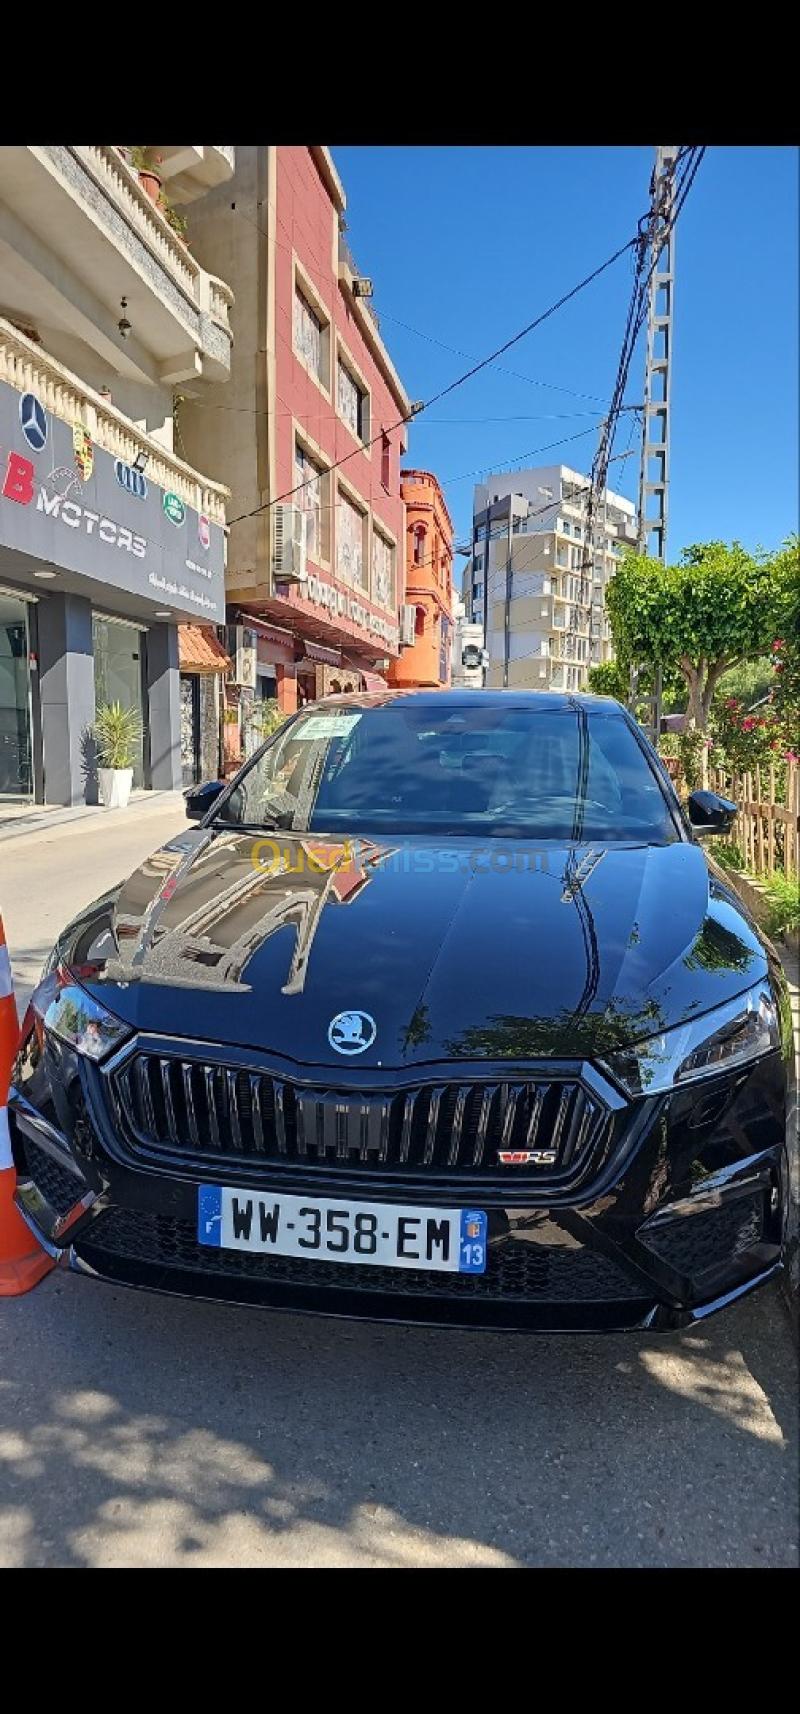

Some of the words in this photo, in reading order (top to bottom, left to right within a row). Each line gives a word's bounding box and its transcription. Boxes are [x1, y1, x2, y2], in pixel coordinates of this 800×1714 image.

[2, 451, 35, 506] B
[36, 486, 147, 558] MOTORS
[205, 1221, 214, 1234] F
[231, 1197, 450, 1261] WW-358-EM
[463, 1244, 484, 1265] 13
